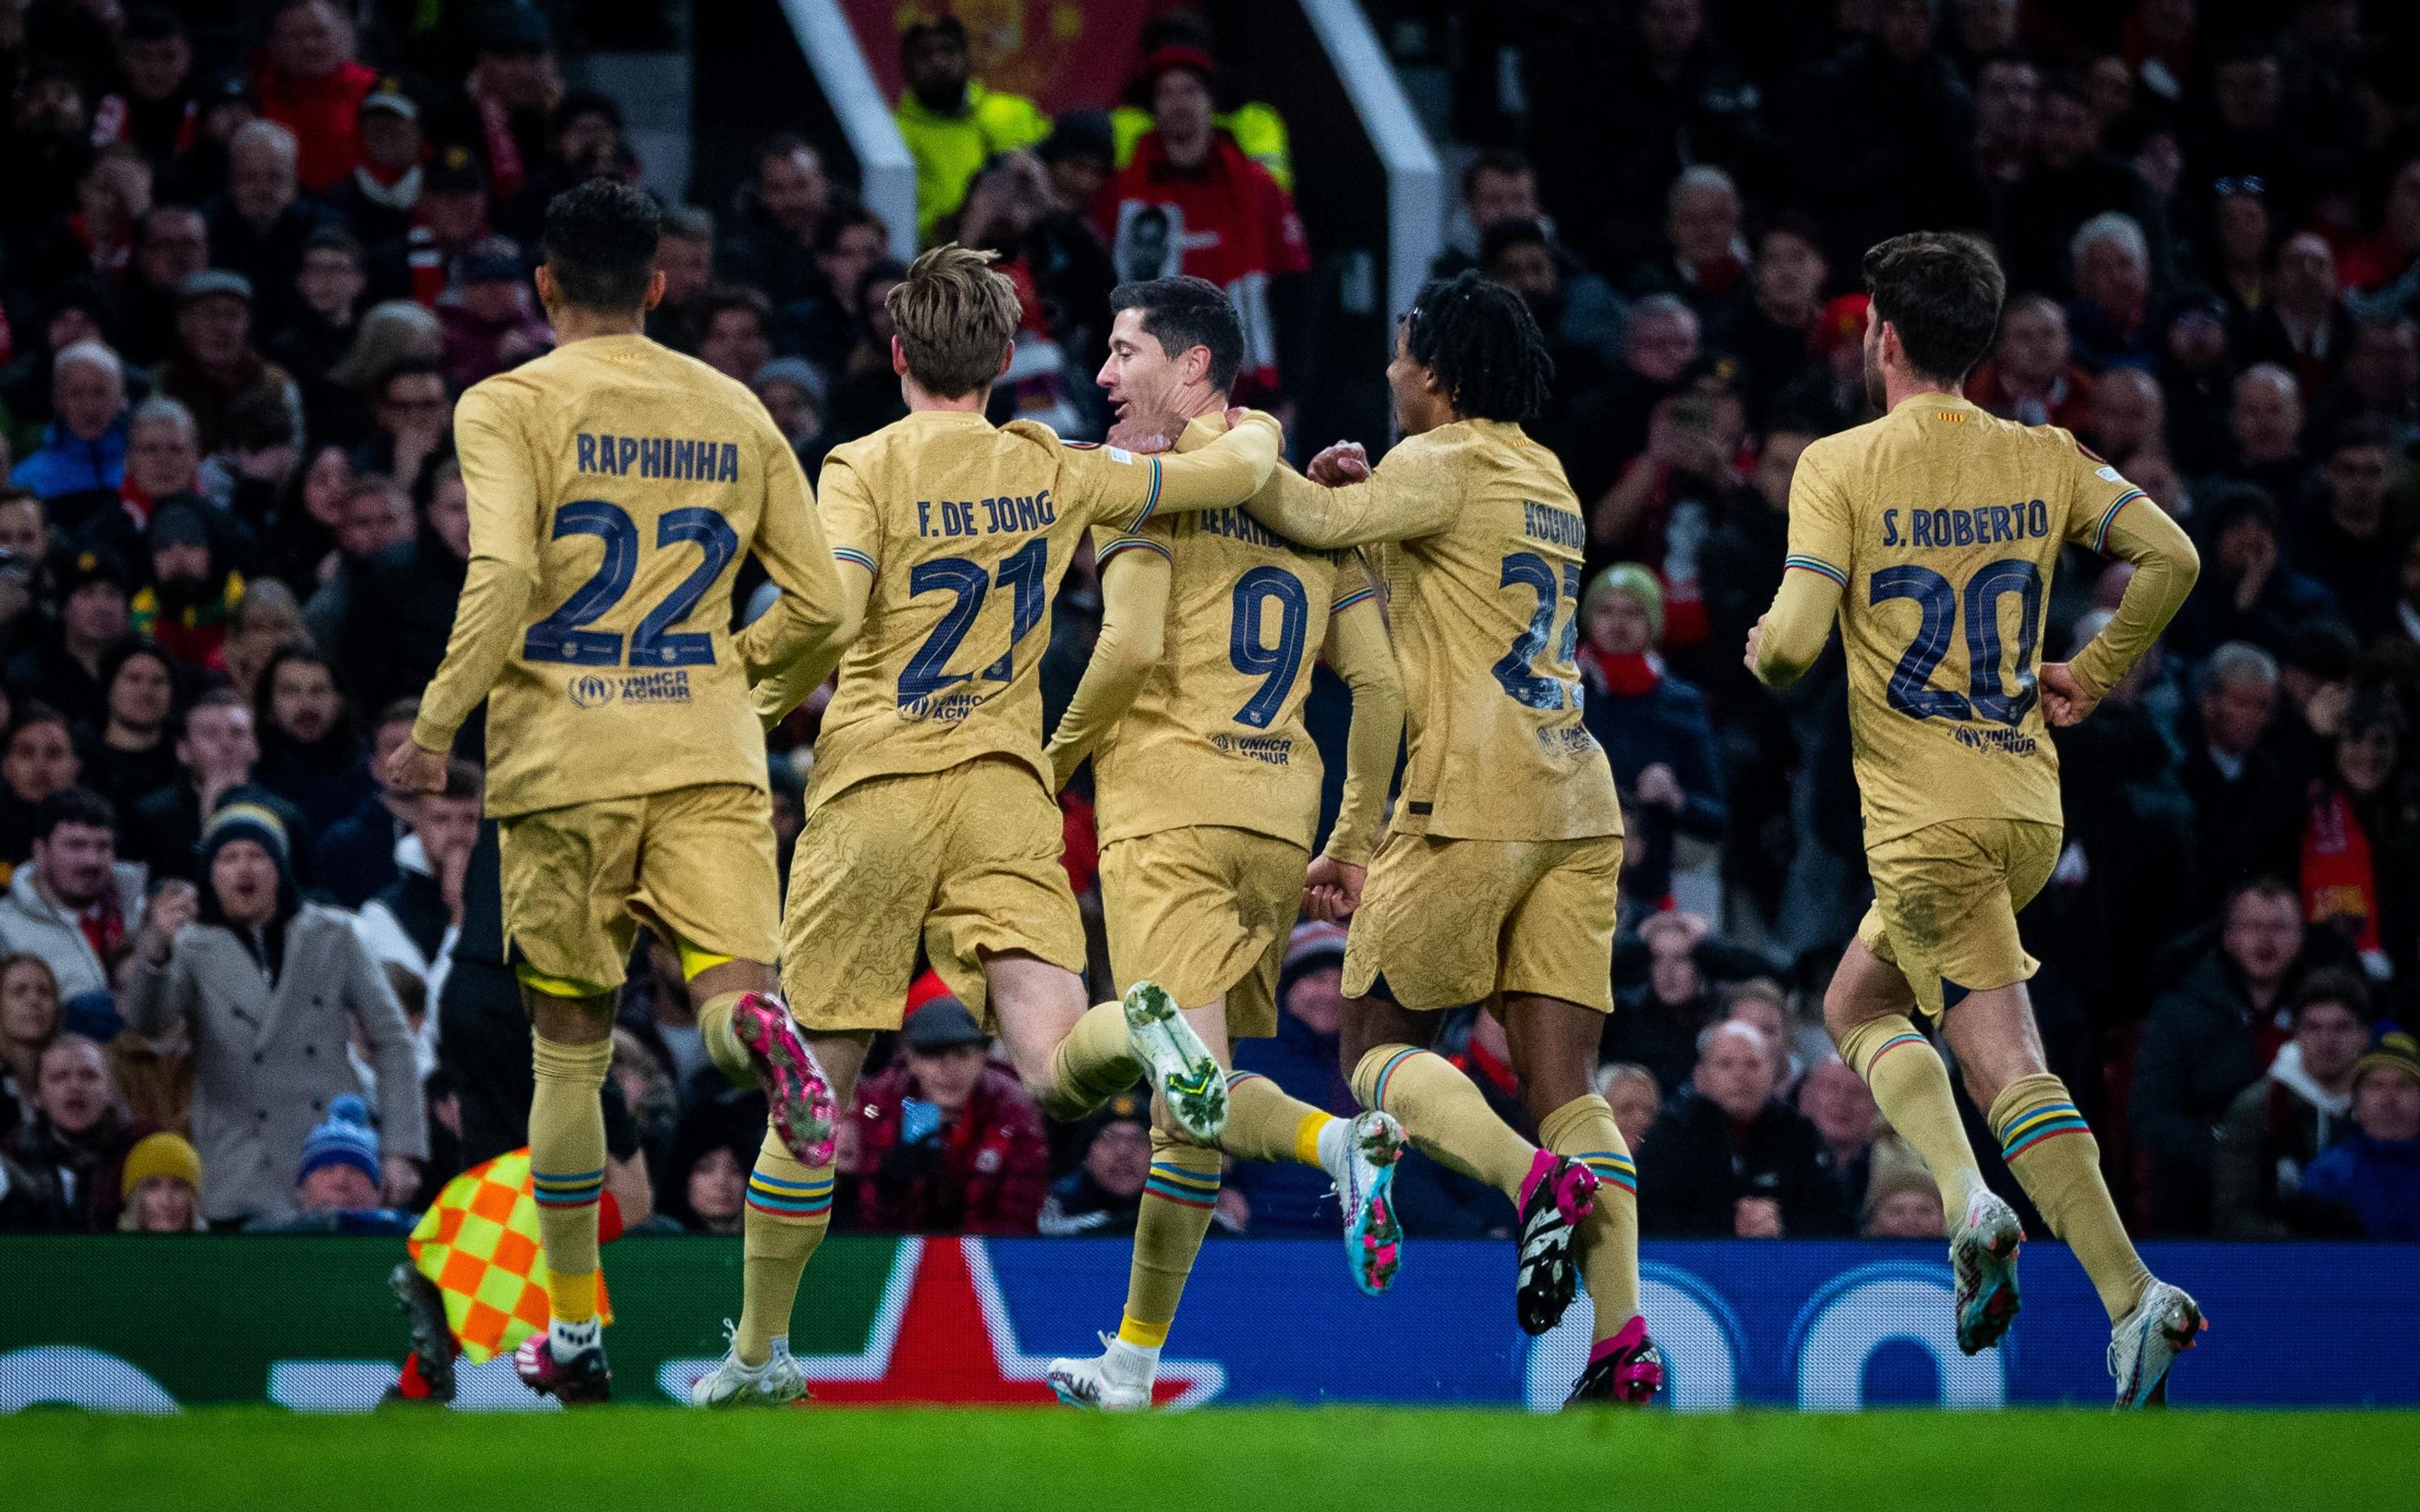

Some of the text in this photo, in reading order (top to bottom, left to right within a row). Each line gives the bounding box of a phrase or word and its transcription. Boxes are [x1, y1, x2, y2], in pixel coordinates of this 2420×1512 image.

[577, 433, 738, 483] RAPHINHA
[981, 490, 1056, 534] JONG
[523, 499, 738, 666] 22
[898, 538, 1048, 708] 21
[1230, 565, 1308, 729] 9
[1869, 559, 2043, 727] 20
[1239, 737, 1292, 752] UNHCR
